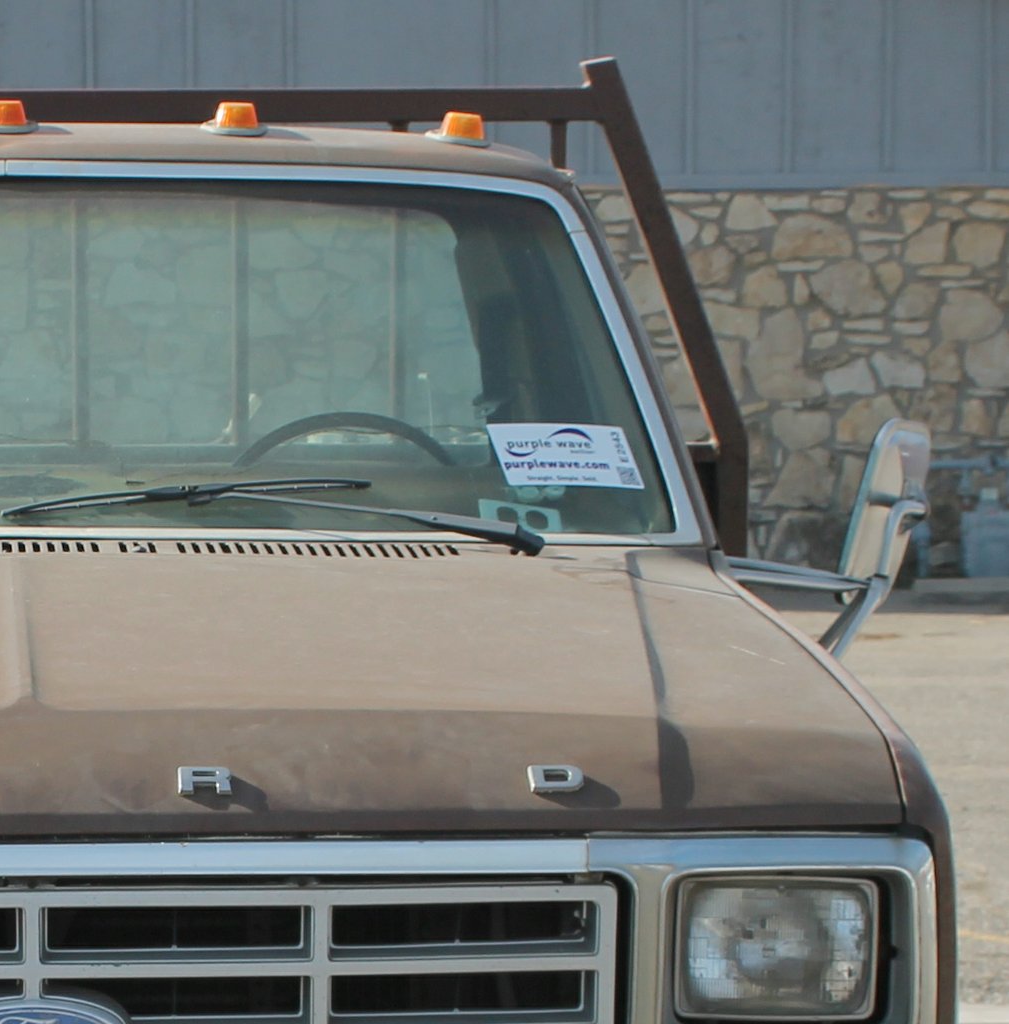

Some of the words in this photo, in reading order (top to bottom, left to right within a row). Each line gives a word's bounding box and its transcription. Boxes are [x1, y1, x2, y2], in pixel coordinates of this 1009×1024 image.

[506, 439, 551, 450] purple
[556, 440, 592, 449] wave
[503, 458, 610, 471] purplewave.com
